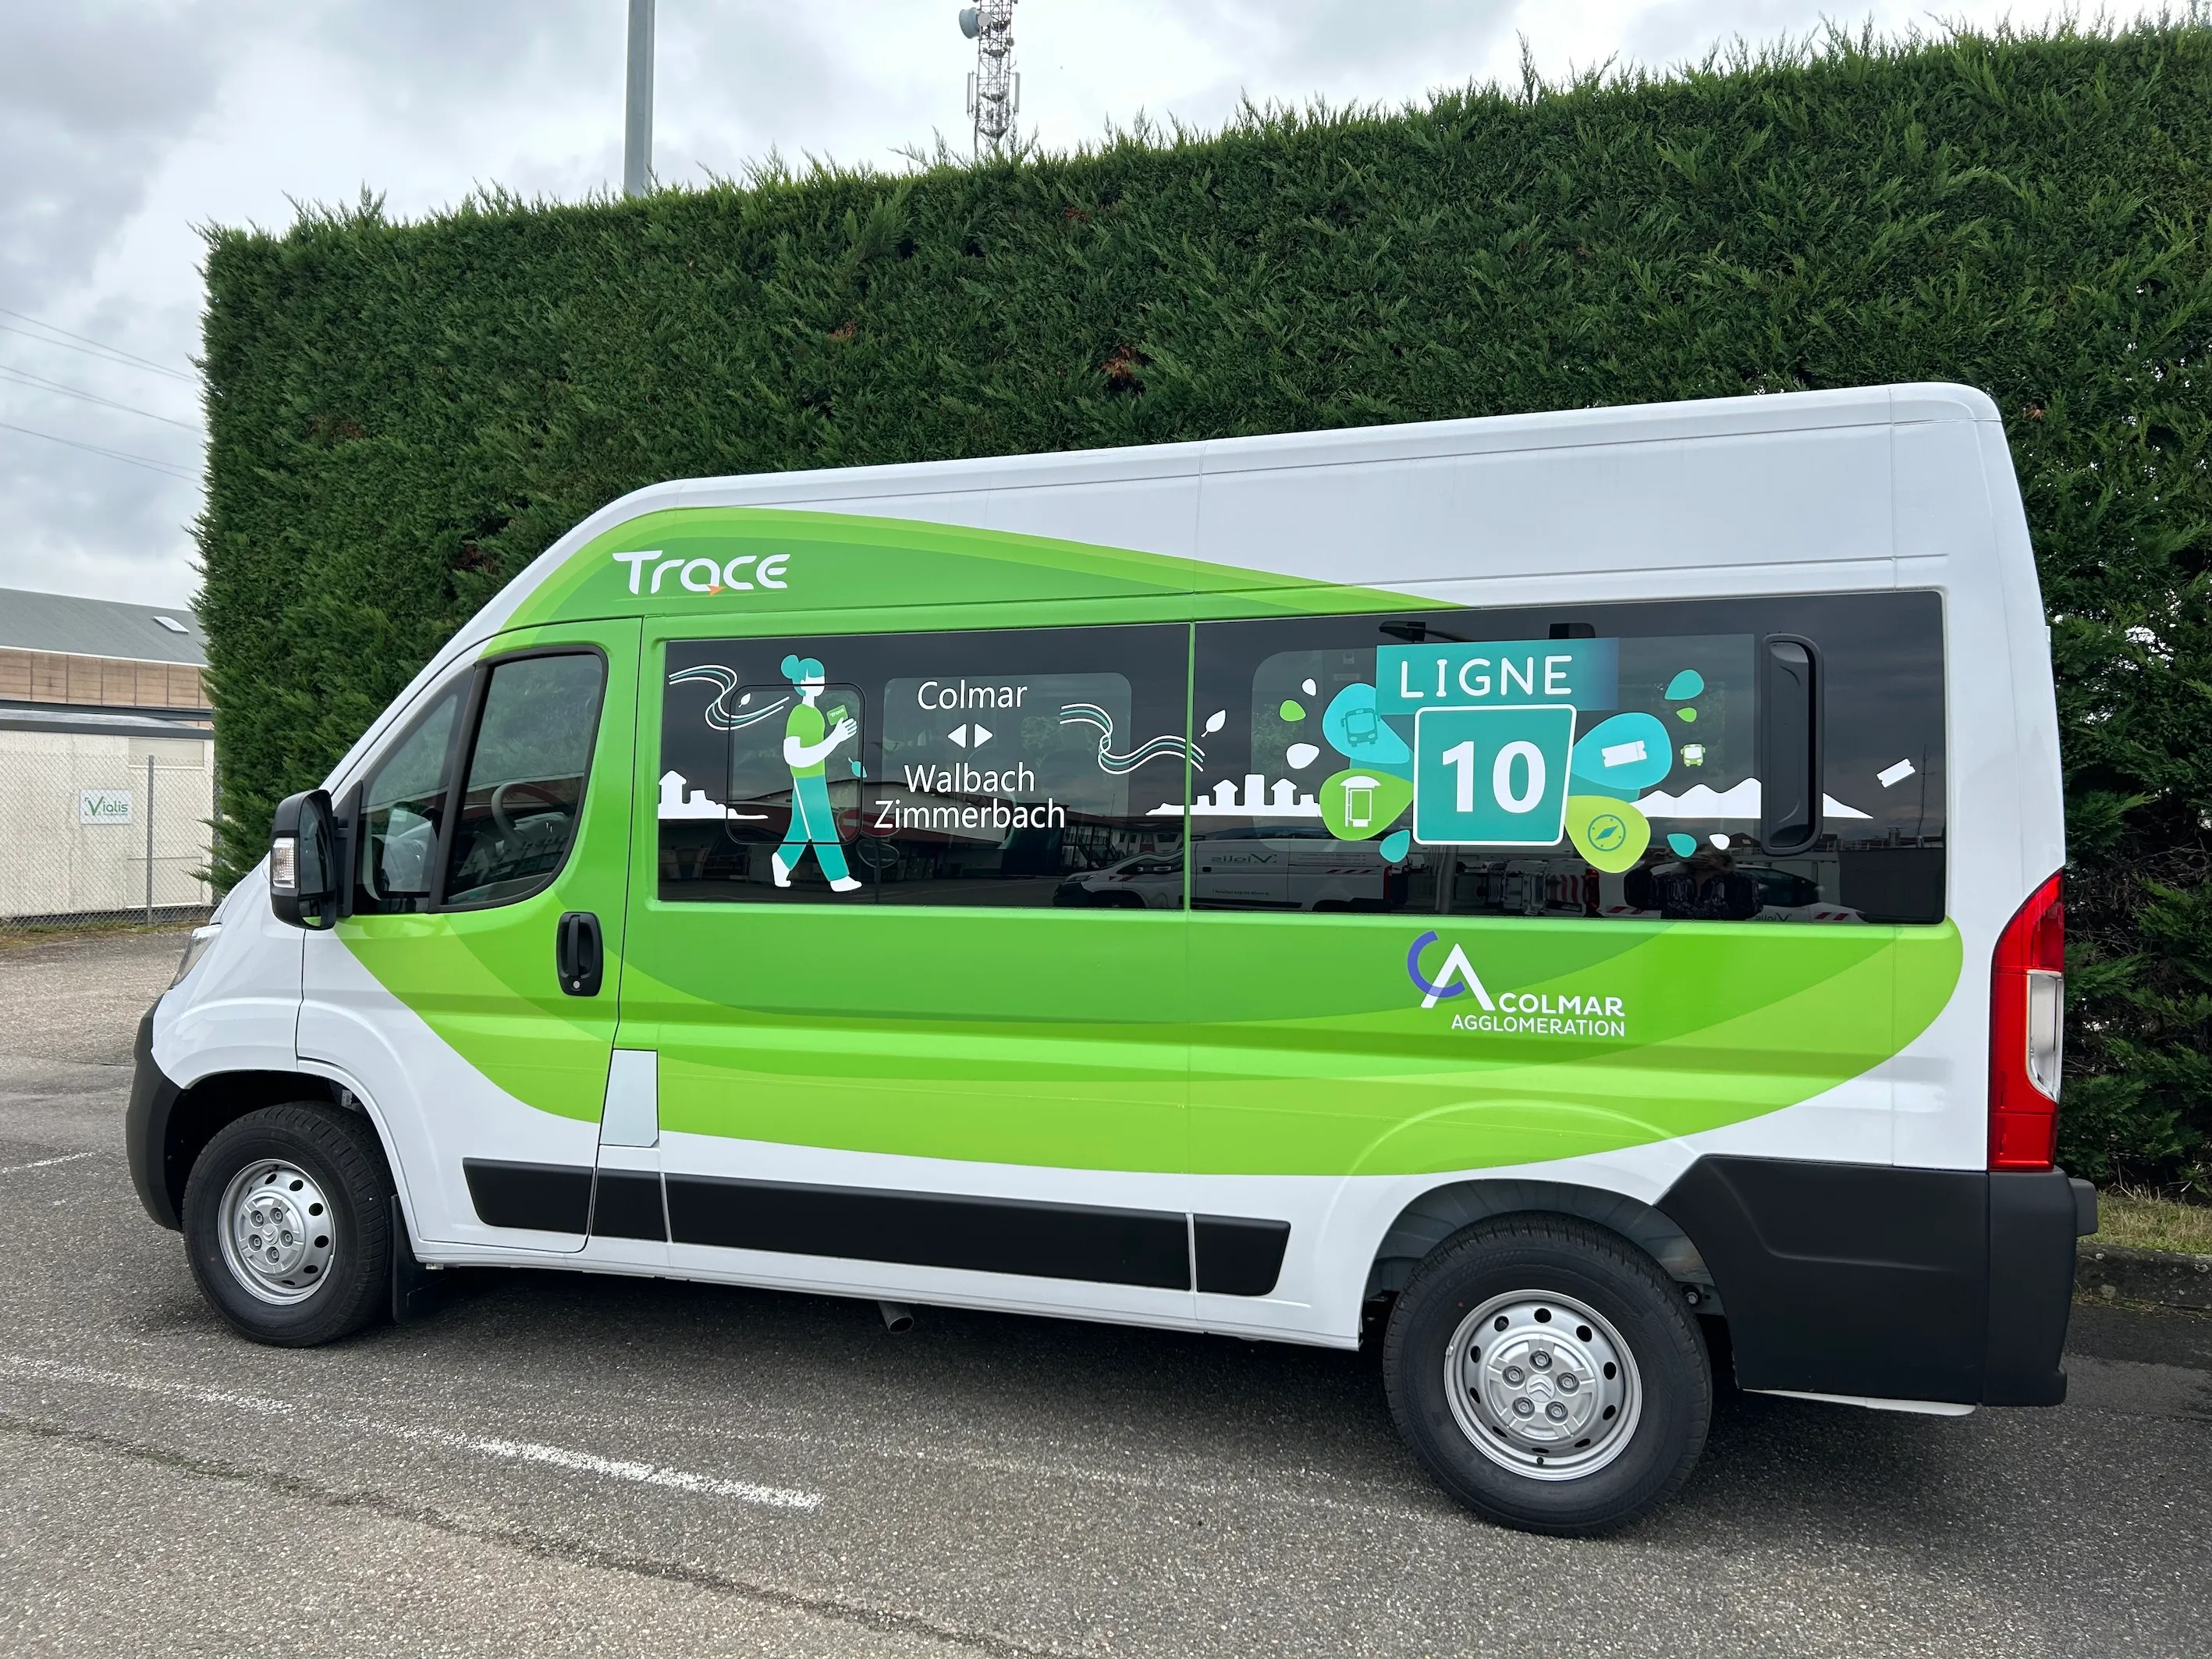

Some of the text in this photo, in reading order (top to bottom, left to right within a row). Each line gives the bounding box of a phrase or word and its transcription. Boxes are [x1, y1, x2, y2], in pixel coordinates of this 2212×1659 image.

[1401, 655, 1573, 698] LIGNE
[918, 679, 1028, 709] Colmar
[904, 761, 1035, 793] Walbach
[1442, 740, 1546, 814] 10
[87, 796, 129, 815] Vialis
[873, 798, 1065, 829] Zimmerbach
[1498, 992, 1625, 1017] COLMAR
[1450, 1014, 1625, 1037] AGGLOMERATION
